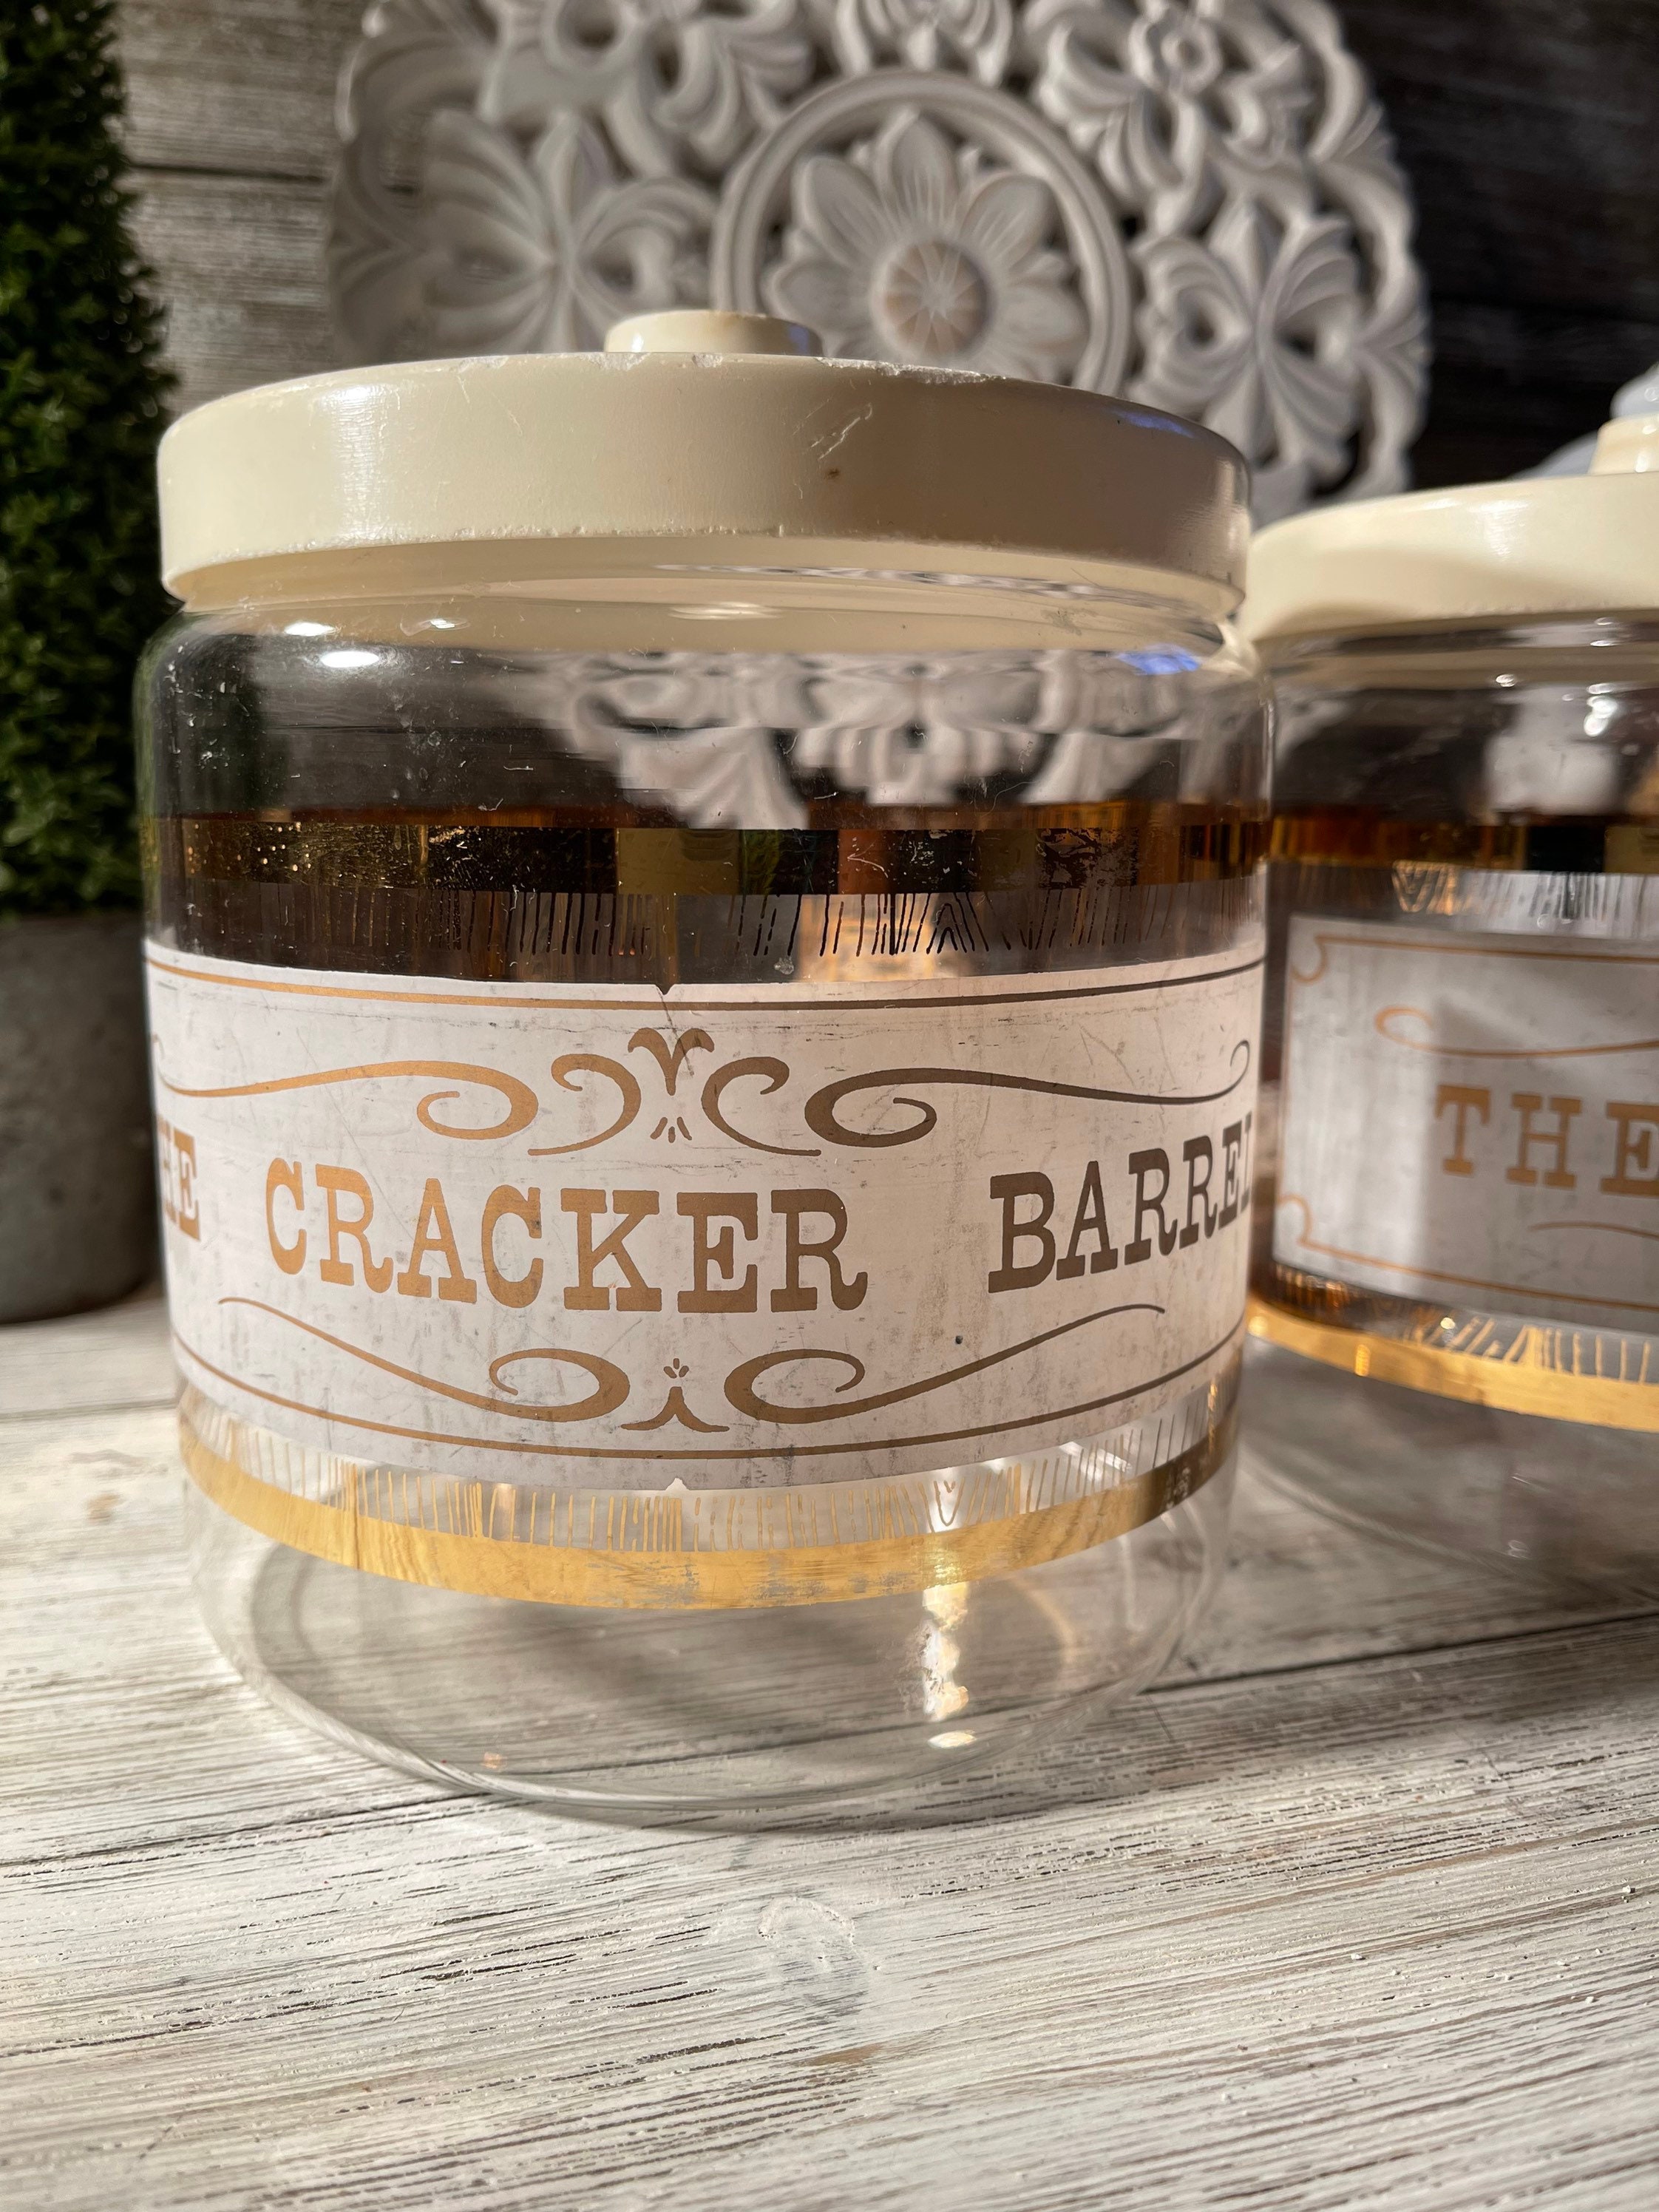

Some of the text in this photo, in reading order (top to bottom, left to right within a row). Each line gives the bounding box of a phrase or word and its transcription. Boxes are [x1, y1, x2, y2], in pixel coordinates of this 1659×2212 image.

[157, 1114, 201, 1241] HE
[265, 1157, 869, 1313] CRACKER
[1434, 1083, 1659, 1198] THE
